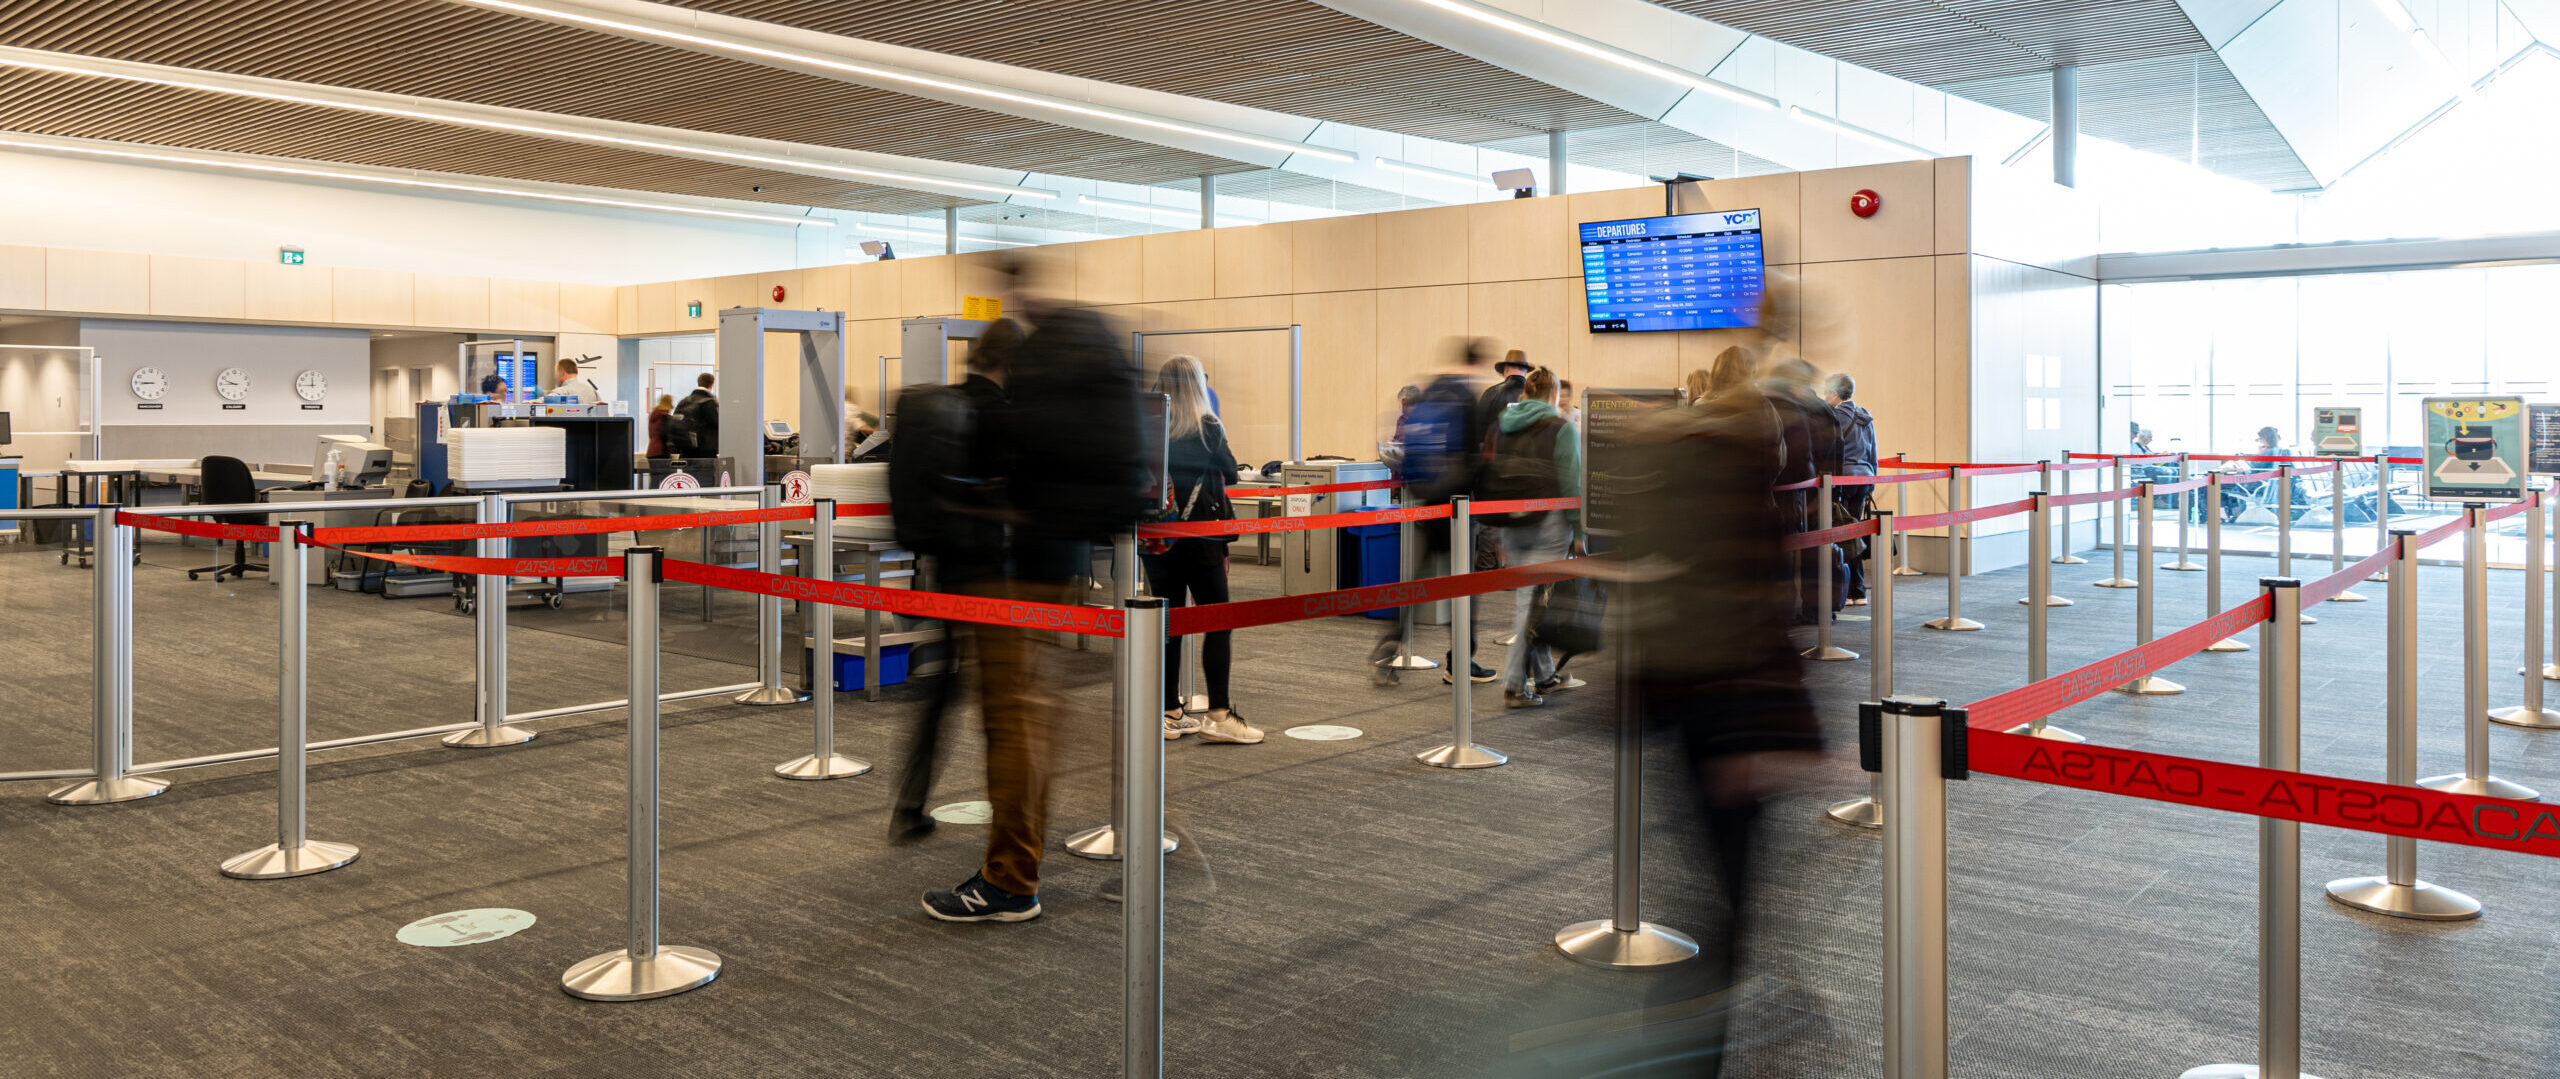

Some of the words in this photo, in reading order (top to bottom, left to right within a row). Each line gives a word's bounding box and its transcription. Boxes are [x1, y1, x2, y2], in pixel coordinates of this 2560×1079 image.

[1597, 223, 1646, 238] DEPARTURES
[697, 512, 744, 525] CATSA
[759, 508, 800, 520] ACSTA
[1375, 511, 1405, 522] CATSA
[1413, 507, 1443, 518] ACSTA
[222, 526, 247, 538] CATSA
[253, 529, 277, 540] ACSTA
[462, 525, 519, 537] CATSA
[535, 522, 588, 533] ACSTA
[1224, 520, 1261, 533] CATSA
[1270, 518, 1306, 530] ACSTA
[514, 559, 554, 574] CATSA
[566, 559, 608, 573] ACSTA
[771, 577, 819, 599] CATSA
[832, 587, 884, 608] ACSTA
[1303, 595, 1361, 616] CATSA
[1376, 584, 1428, 606] ACSTA
[1010, 605, 1075, 629] CATSA
[2209, 612, 2236, 641] CATSA
[2242, 600, 2265, 628] ACSTA
[2061, 668, 2103, 702] CATSA
[2111, 651, 2147, 684] ACSTA
[960, 889, 988, 912] N
